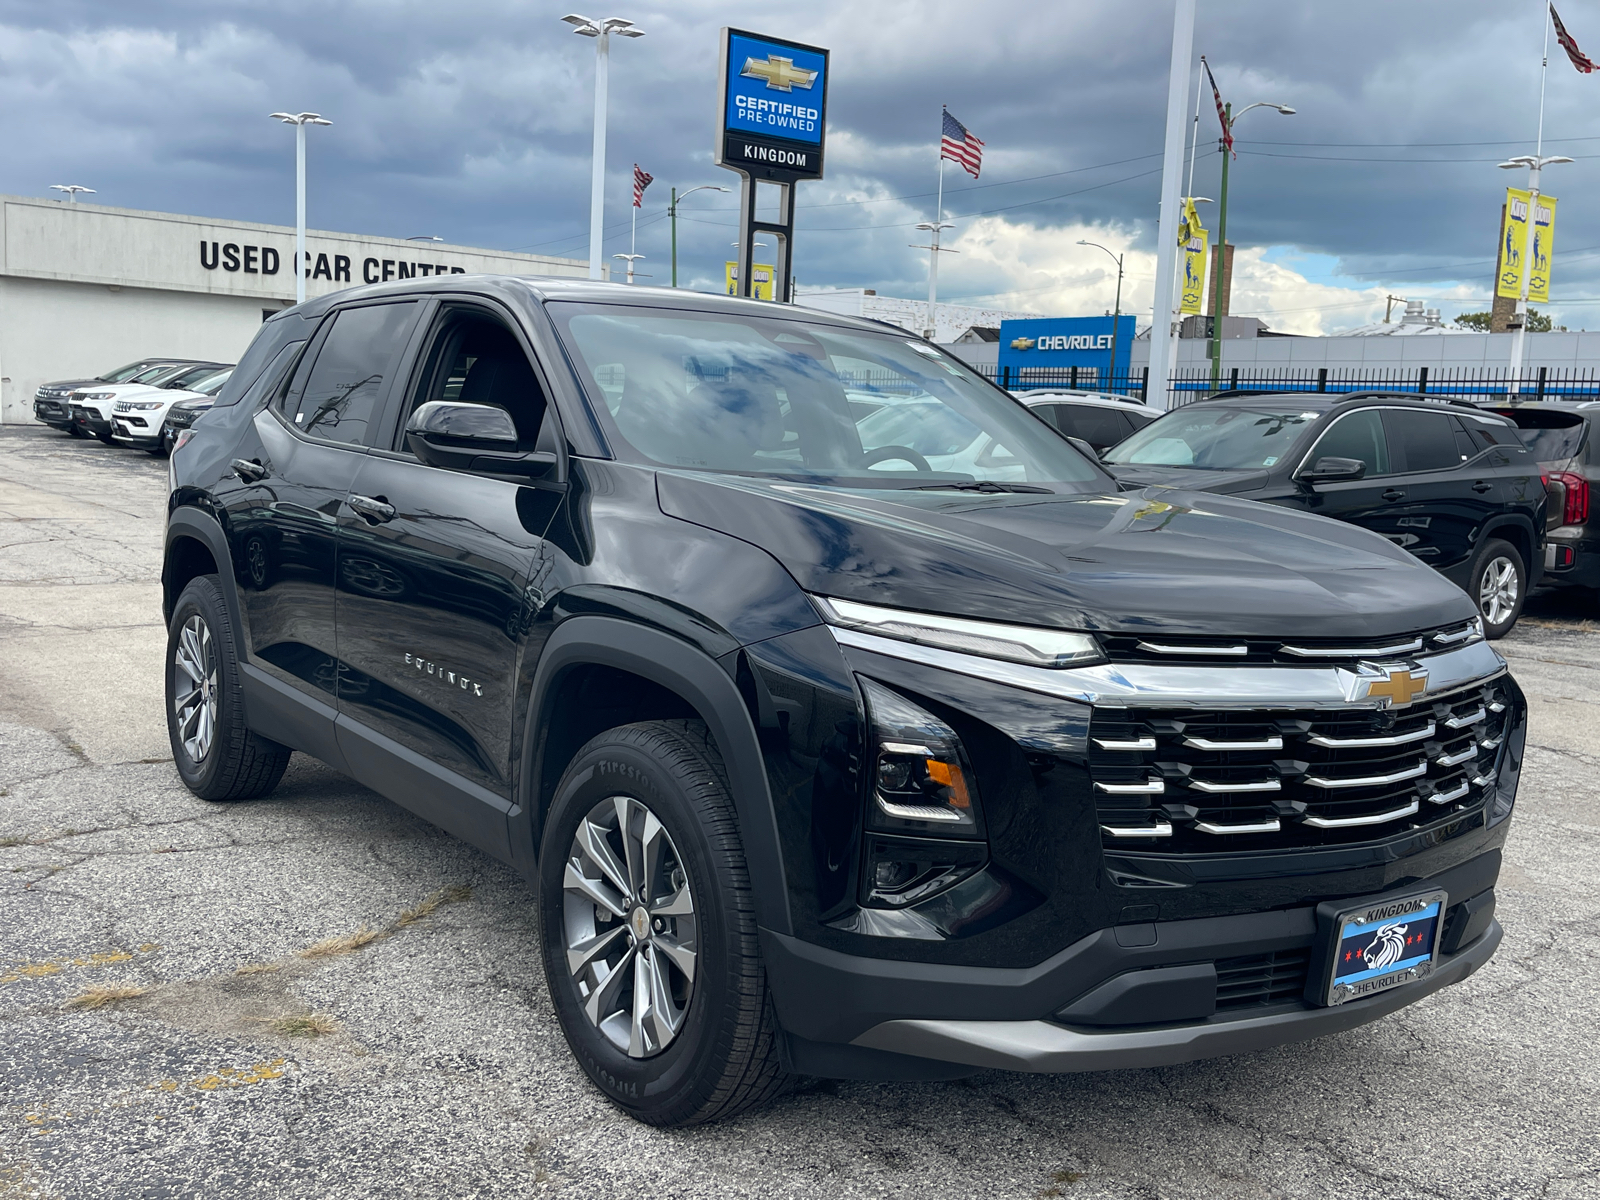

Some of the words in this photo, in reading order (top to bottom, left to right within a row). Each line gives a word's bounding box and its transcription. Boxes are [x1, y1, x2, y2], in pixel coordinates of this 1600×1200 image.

[735, 95, 818, 120] CERTIFIED
[738, 108, 815, 132] PRE-OWNED
[744, 144, 806, 167] KINGDOM
[200, 240, 280, 275] USED
[294, 251, 351, 283] CAR
[1037, 334, 1114, 350] CHEVROLET
[404, 652, 484, 697] EQUINOX
[1366, 899, 1422, 922] KINGDOM
[1352, 971, 1411, 996] CHEVROLET
